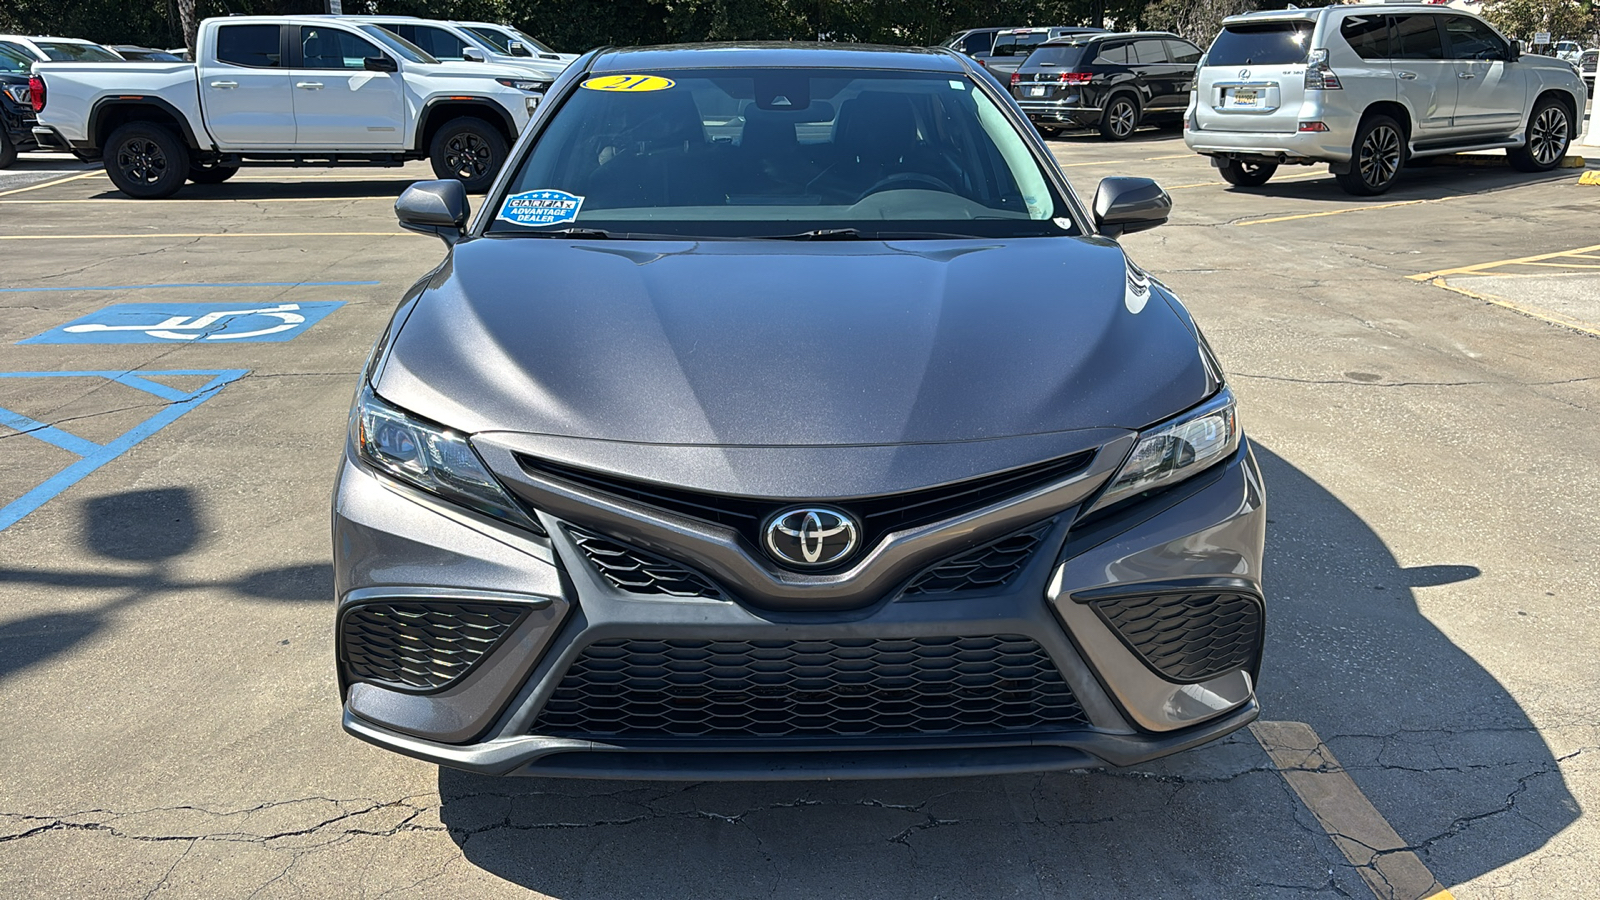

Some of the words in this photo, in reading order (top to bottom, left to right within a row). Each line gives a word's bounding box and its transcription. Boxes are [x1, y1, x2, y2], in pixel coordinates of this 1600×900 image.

[602, 77, 650, 89] 21
[509, 200, 575, 209] CARFAX
[510, 208, 567, 216] ADVANTAGE
[517, 214, 555, 222] DEALER
